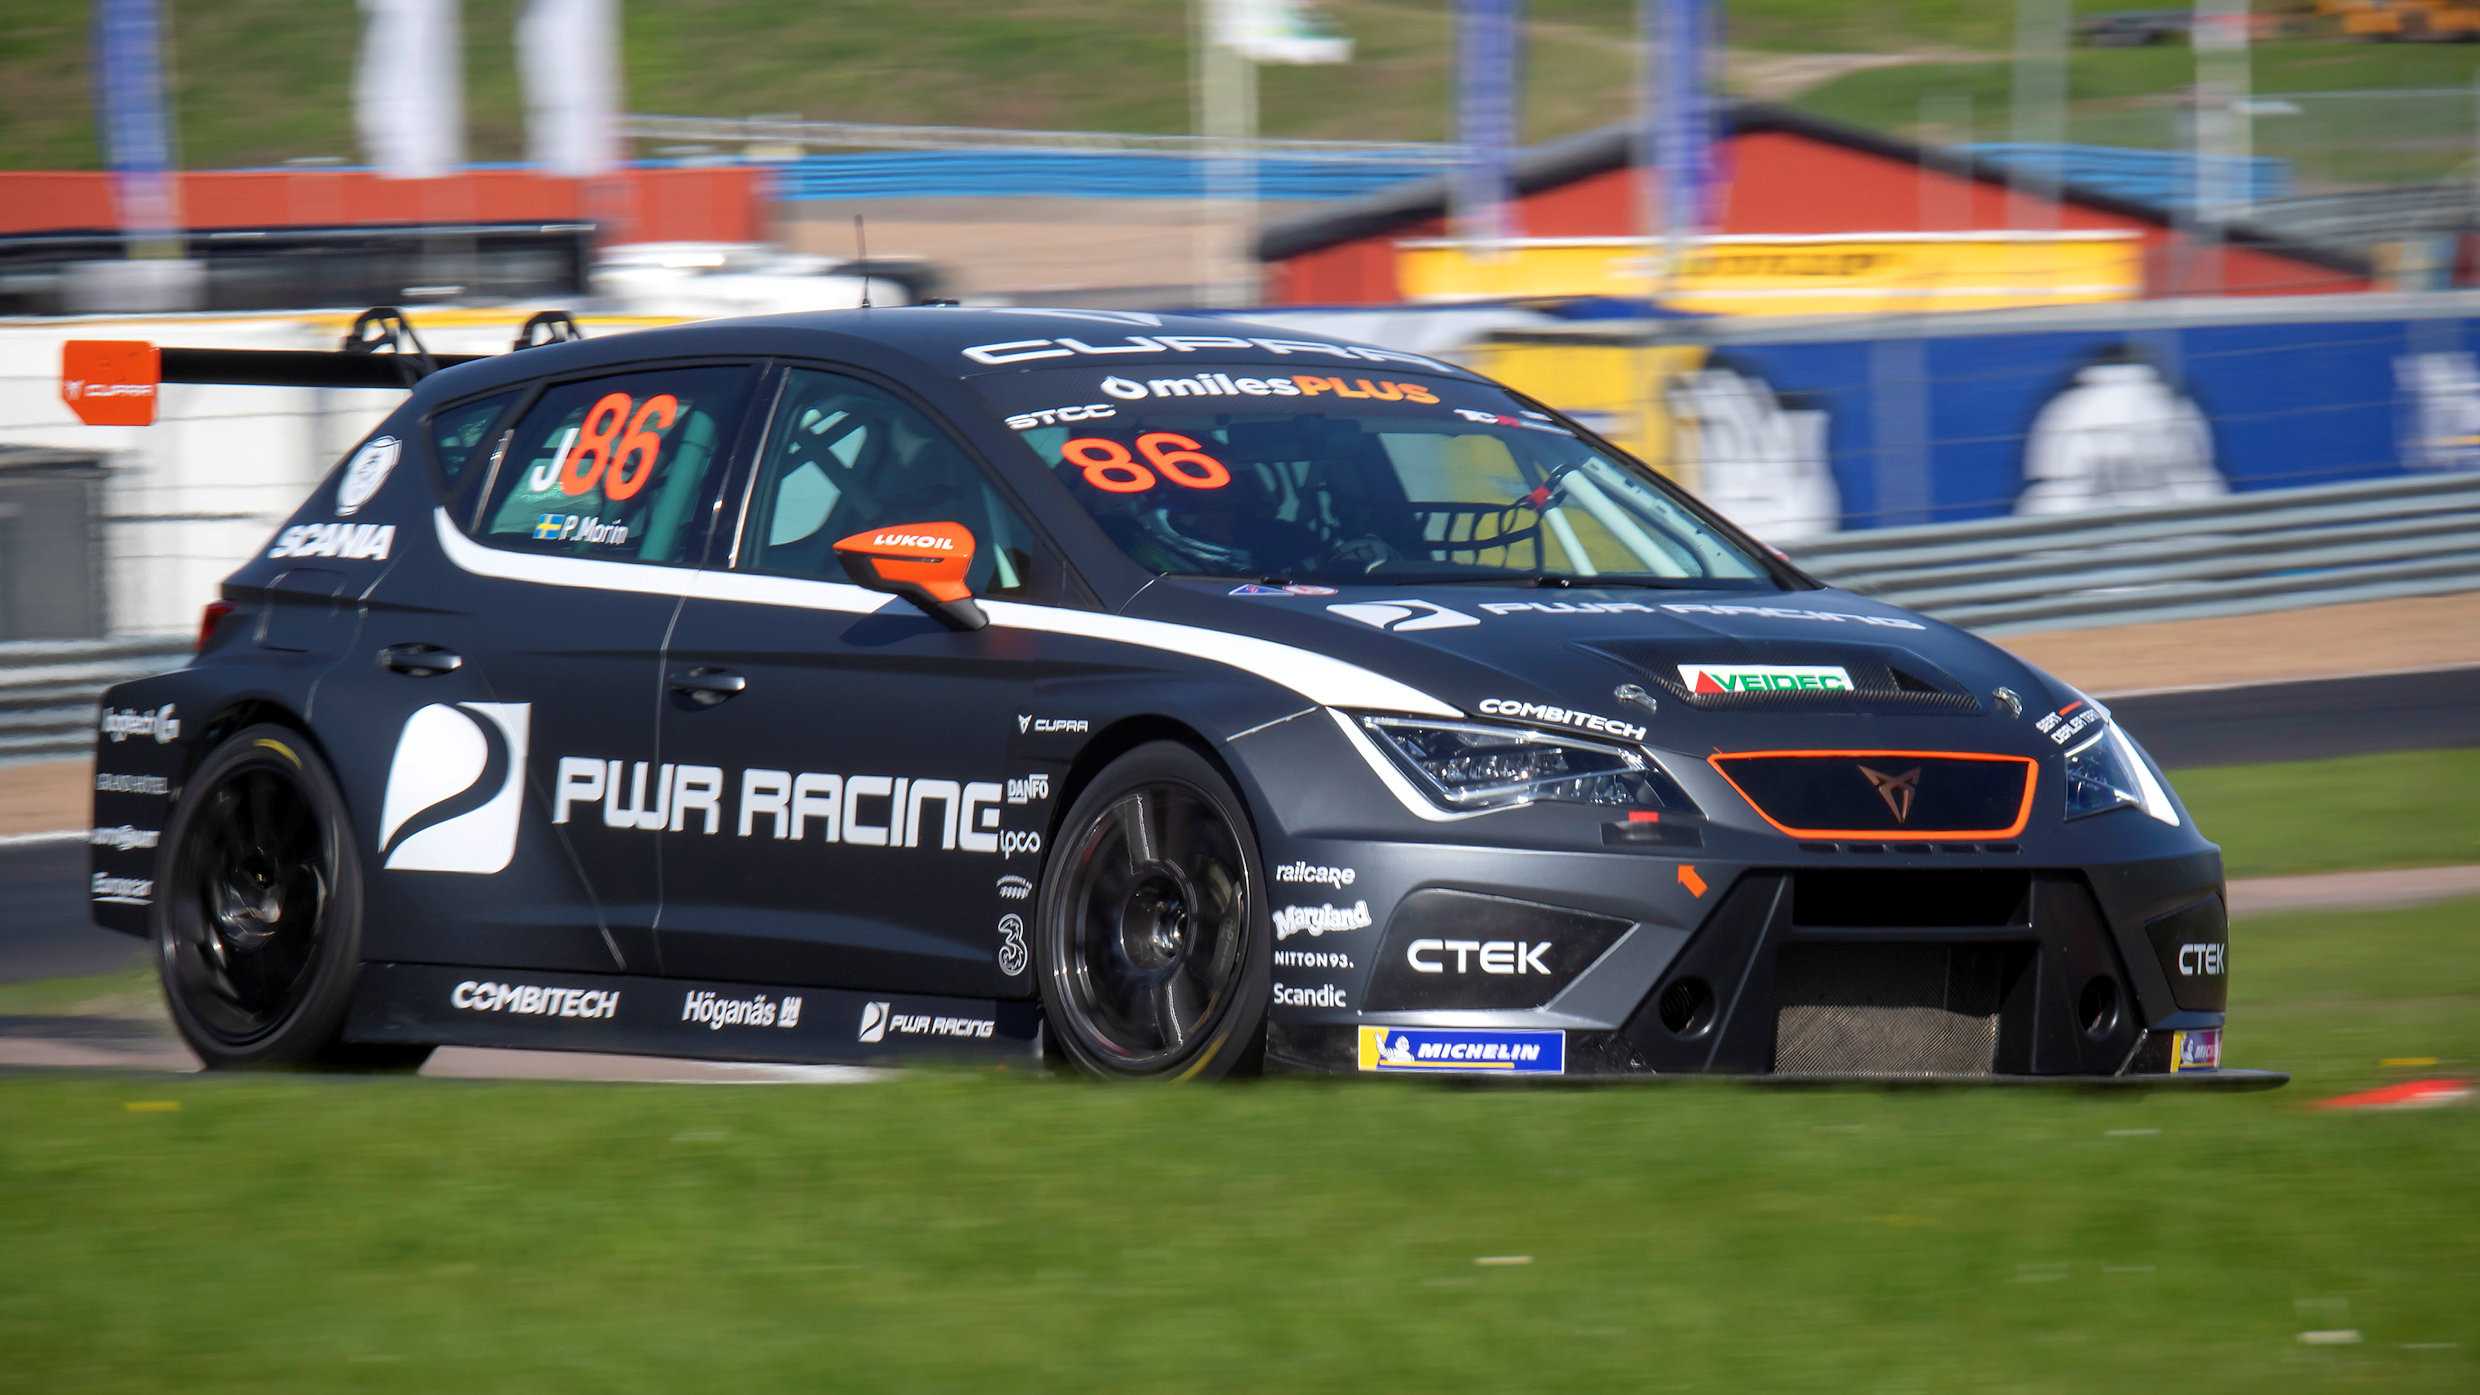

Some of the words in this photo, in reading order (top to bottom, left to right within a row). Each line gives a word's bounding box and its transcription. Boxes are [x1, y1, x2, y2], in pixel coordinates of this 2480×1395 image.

[961, 335, 1454, 373] CUPRA
[1004, 404, 1117, 430] STCC
[1061, 432, 1230, 493] 86
[267, 523, 396, 561] SCANIA
[873, 534, 954, 550] LUKOIL
[1478, 602, 1655, 615] PWR
[1658, 603, 1928, 630] RACING
[1710, 674, 1845, 692] VEIDEC
[1034, 719, 1089, 732] CUPRA
[1478, 698, 1647, 741] COMBITECH
[552, 756, 723, 835] PWR
[738, 769, 1002, 853] RACING
[1007, 773, 1049, 804] DANFO
[1275, 861, 1356, 890] railcare
[1272, 899, 1373, 941] Maryland
[1406, 938, 1552, 975] CTEK
[2178, 943, 2225, 976] CTEK
[451, 980, 621, 1018] COMBITECH
[682, 990, 777, 1030] Höganäs
[1273, 982, 1347, 1008] Scandic
[888, 1014, 931, 1034] PWR
[931, 1017, 996, 1038] RACING
[1417, 1042, 1541, 1061] MICHELIN
